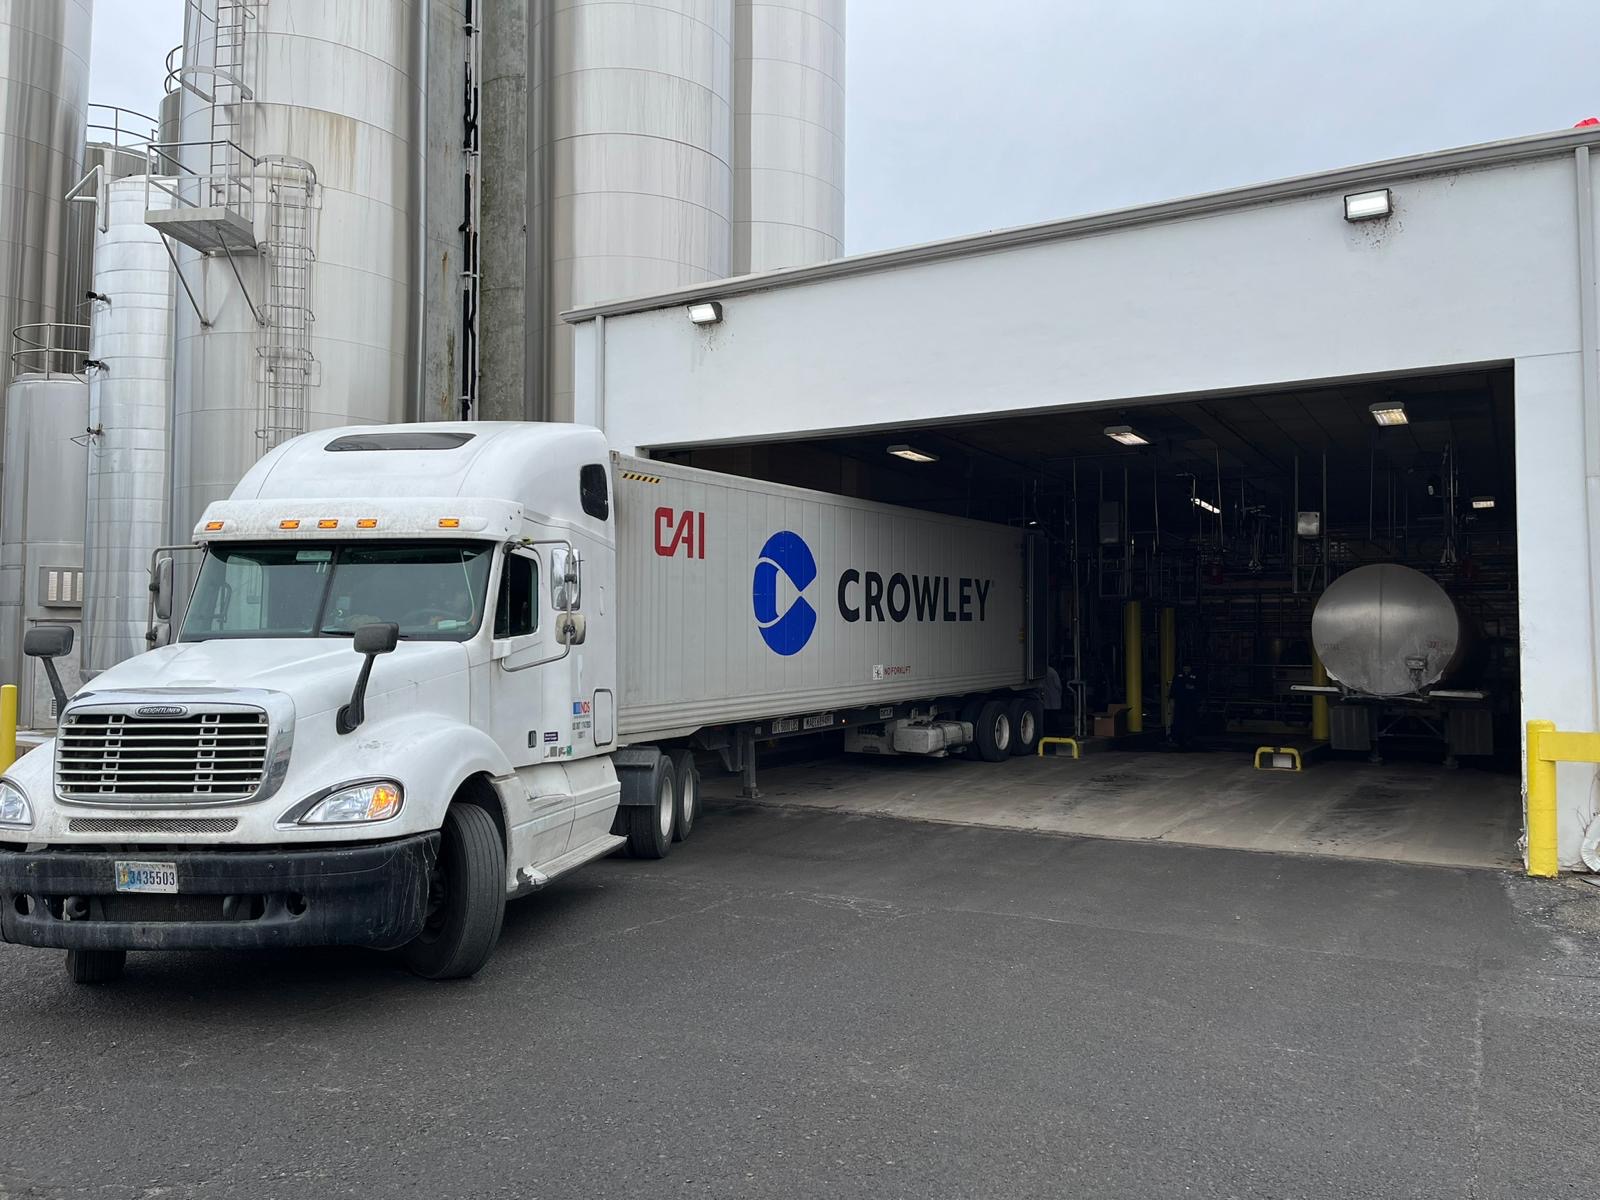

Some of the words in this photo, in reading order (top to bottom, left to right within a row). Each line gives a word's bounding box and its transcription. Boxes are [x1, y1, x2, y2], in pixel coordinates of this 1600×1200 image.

[655, 507, 705, 559] CAI
[837, 568, 990, 623] CROWLEY
[891, 666, 911, 675] FORKLIFT
[129, 870, 175, 886] 3435503
